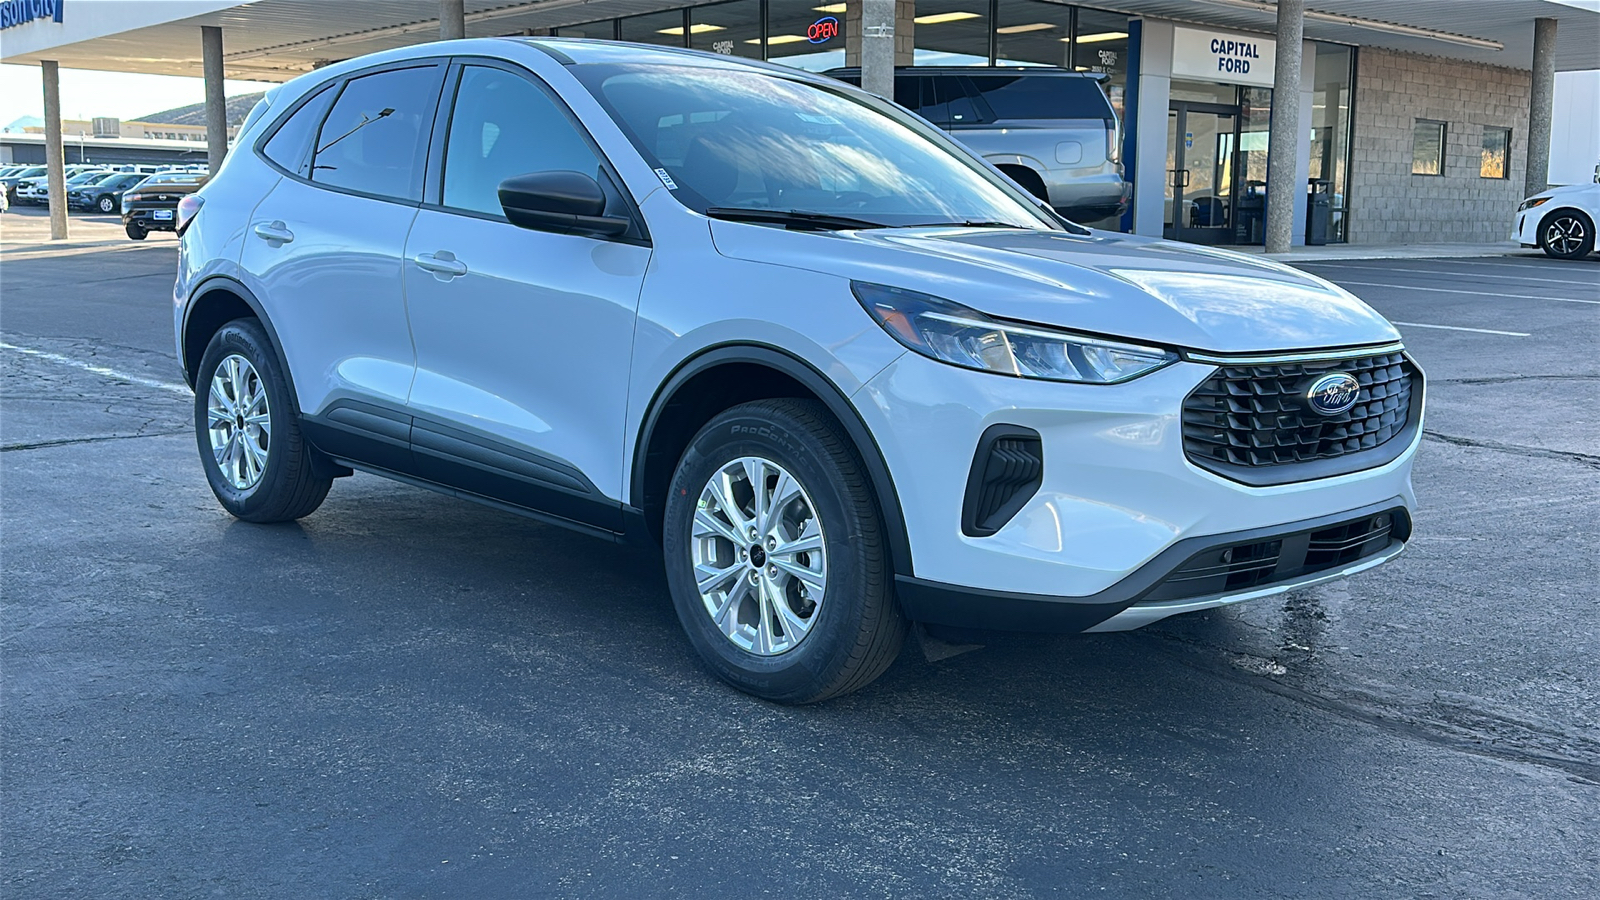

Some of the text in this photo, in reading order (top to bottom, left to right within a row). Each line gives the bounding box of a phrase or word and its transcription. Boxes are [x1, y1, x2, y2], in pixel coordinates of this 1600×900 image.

[807, 22, 838, 39] OPEN
[712, 40, 734, 50] CAPITAL
[1210, 38, 1259, 58] CAPITAL
[1098, 49, 1118, 60] CAPITAL
[1101, 57, 1116, 66] FORD
[1218, 57, 1250, 74] FORD
[1323, 383, 1352, 405] Ford
